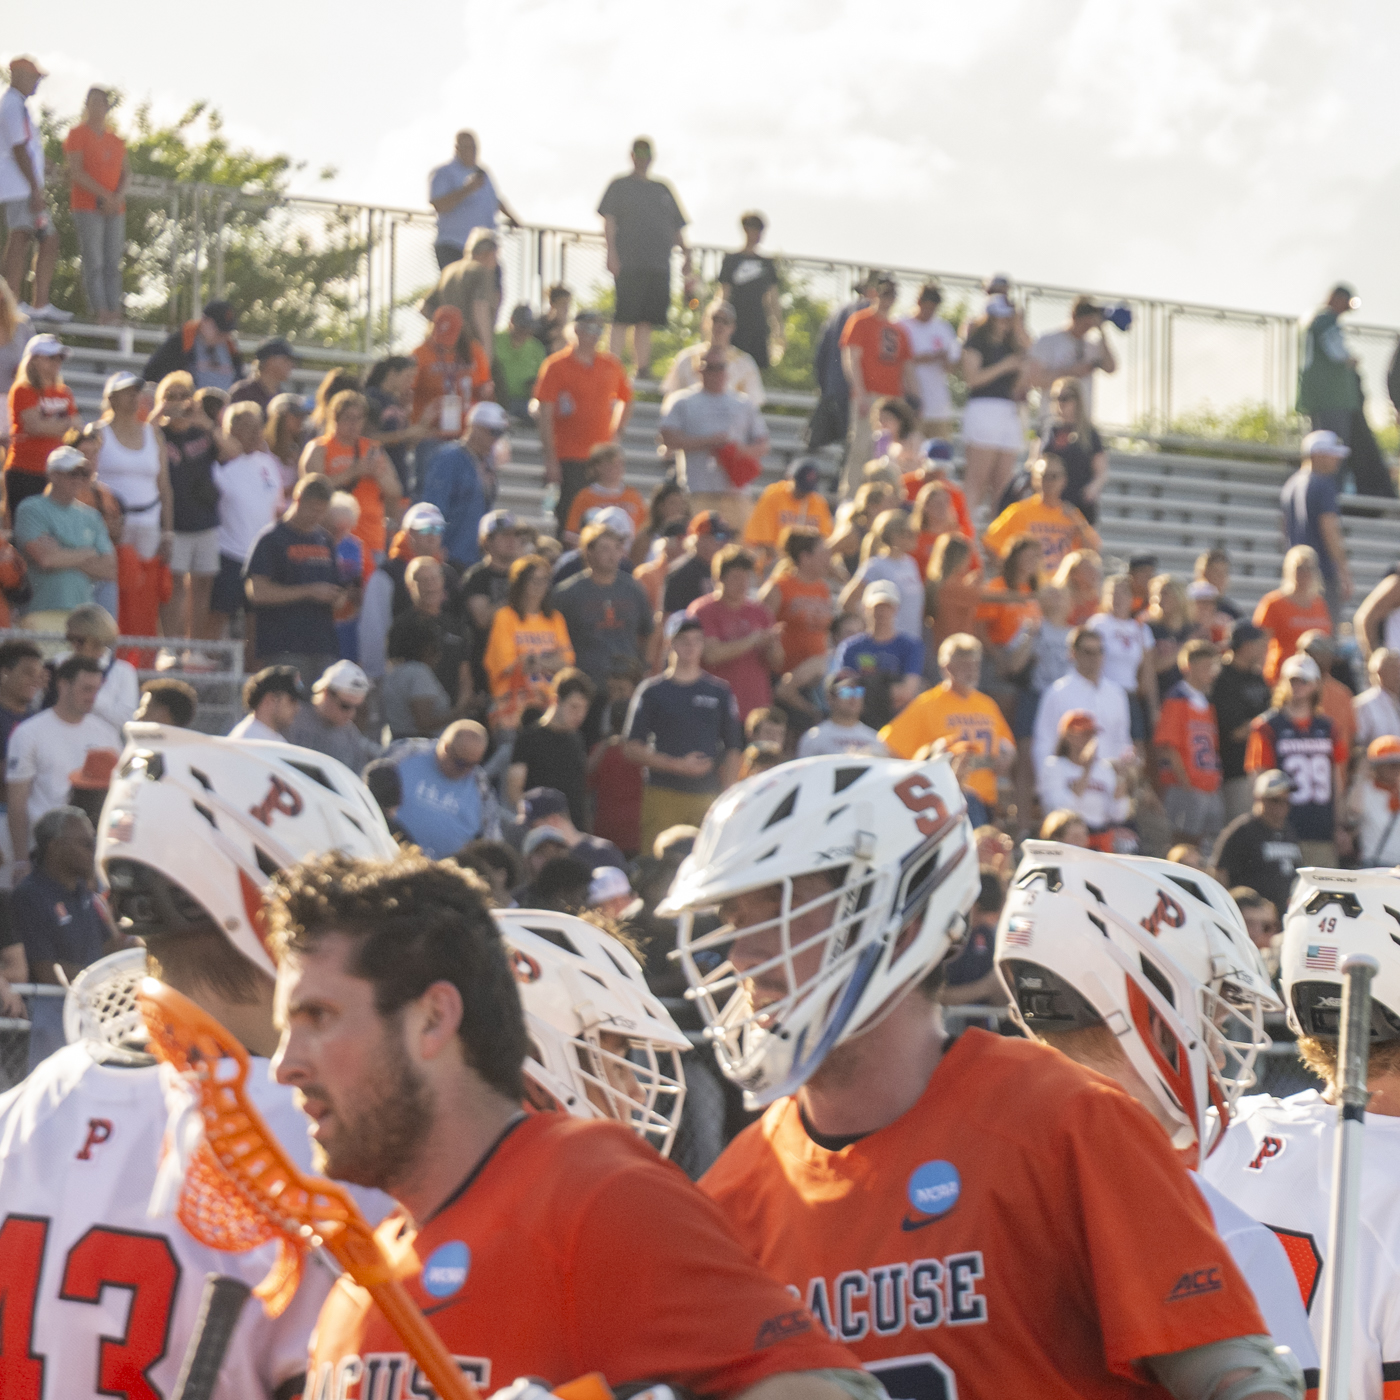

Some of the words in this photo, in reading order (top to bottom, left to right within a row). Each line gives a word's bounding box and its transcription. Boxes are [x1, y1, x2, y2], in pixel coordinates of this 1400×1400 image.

[250, 774, 304, 827] P
[1281, 752, 1332, 805] 39
[894, 773, 949, 838] S
[1312, 874, 1358, 884] cascade
[1140, 889, 1186, 937] P
[1317, 917, 1338, 933] 49
[76, 1118, 113, 1160] P
[1245, 1134, 1288, 1173] P
[785, 1250, 988, 1345] ACUSE
